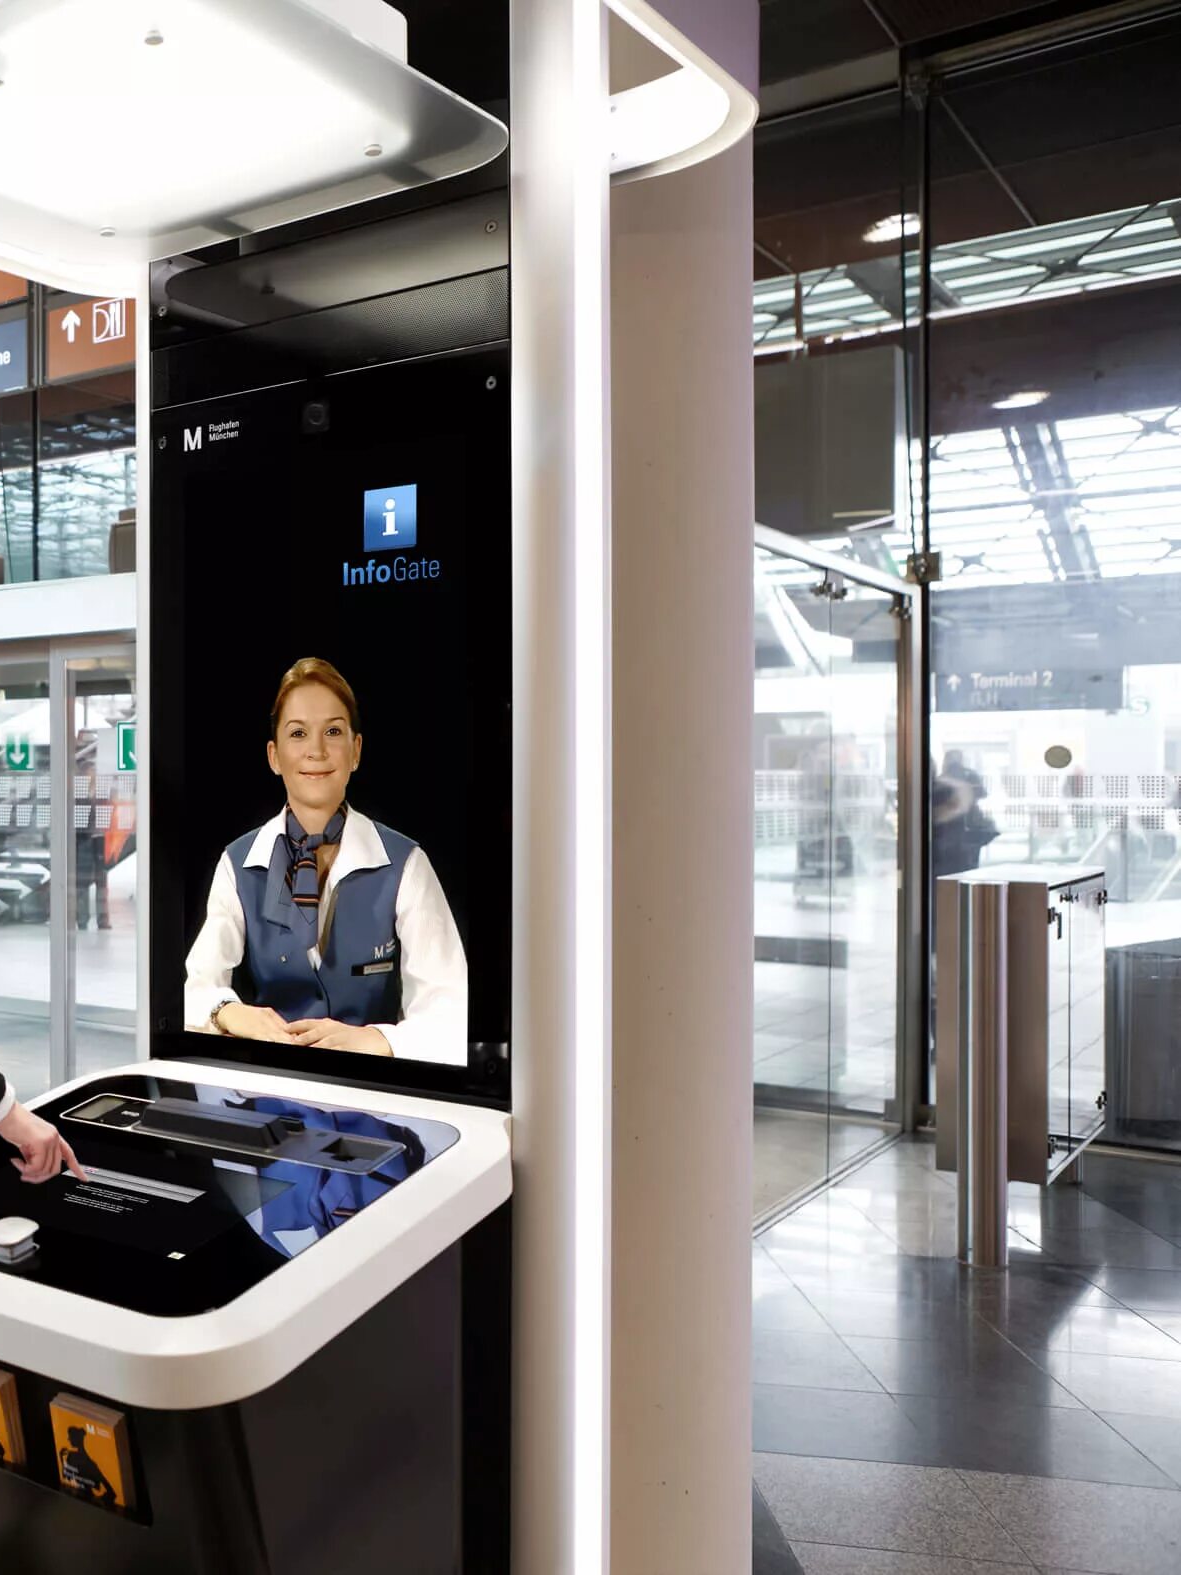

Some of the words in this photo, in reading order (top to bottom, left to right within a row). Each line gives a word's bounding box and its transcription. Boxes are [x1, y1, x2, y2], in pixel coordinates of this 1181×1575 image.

[183, 425, 202, 452] M
[209, 420, 239, 433] Flughafen
[209, 430, 239, 442] München
[343, 556, 440, 586] InfoGate
[970, 671, 1037, 689] Terminal
[1042, 670, 1053, 688] 2
